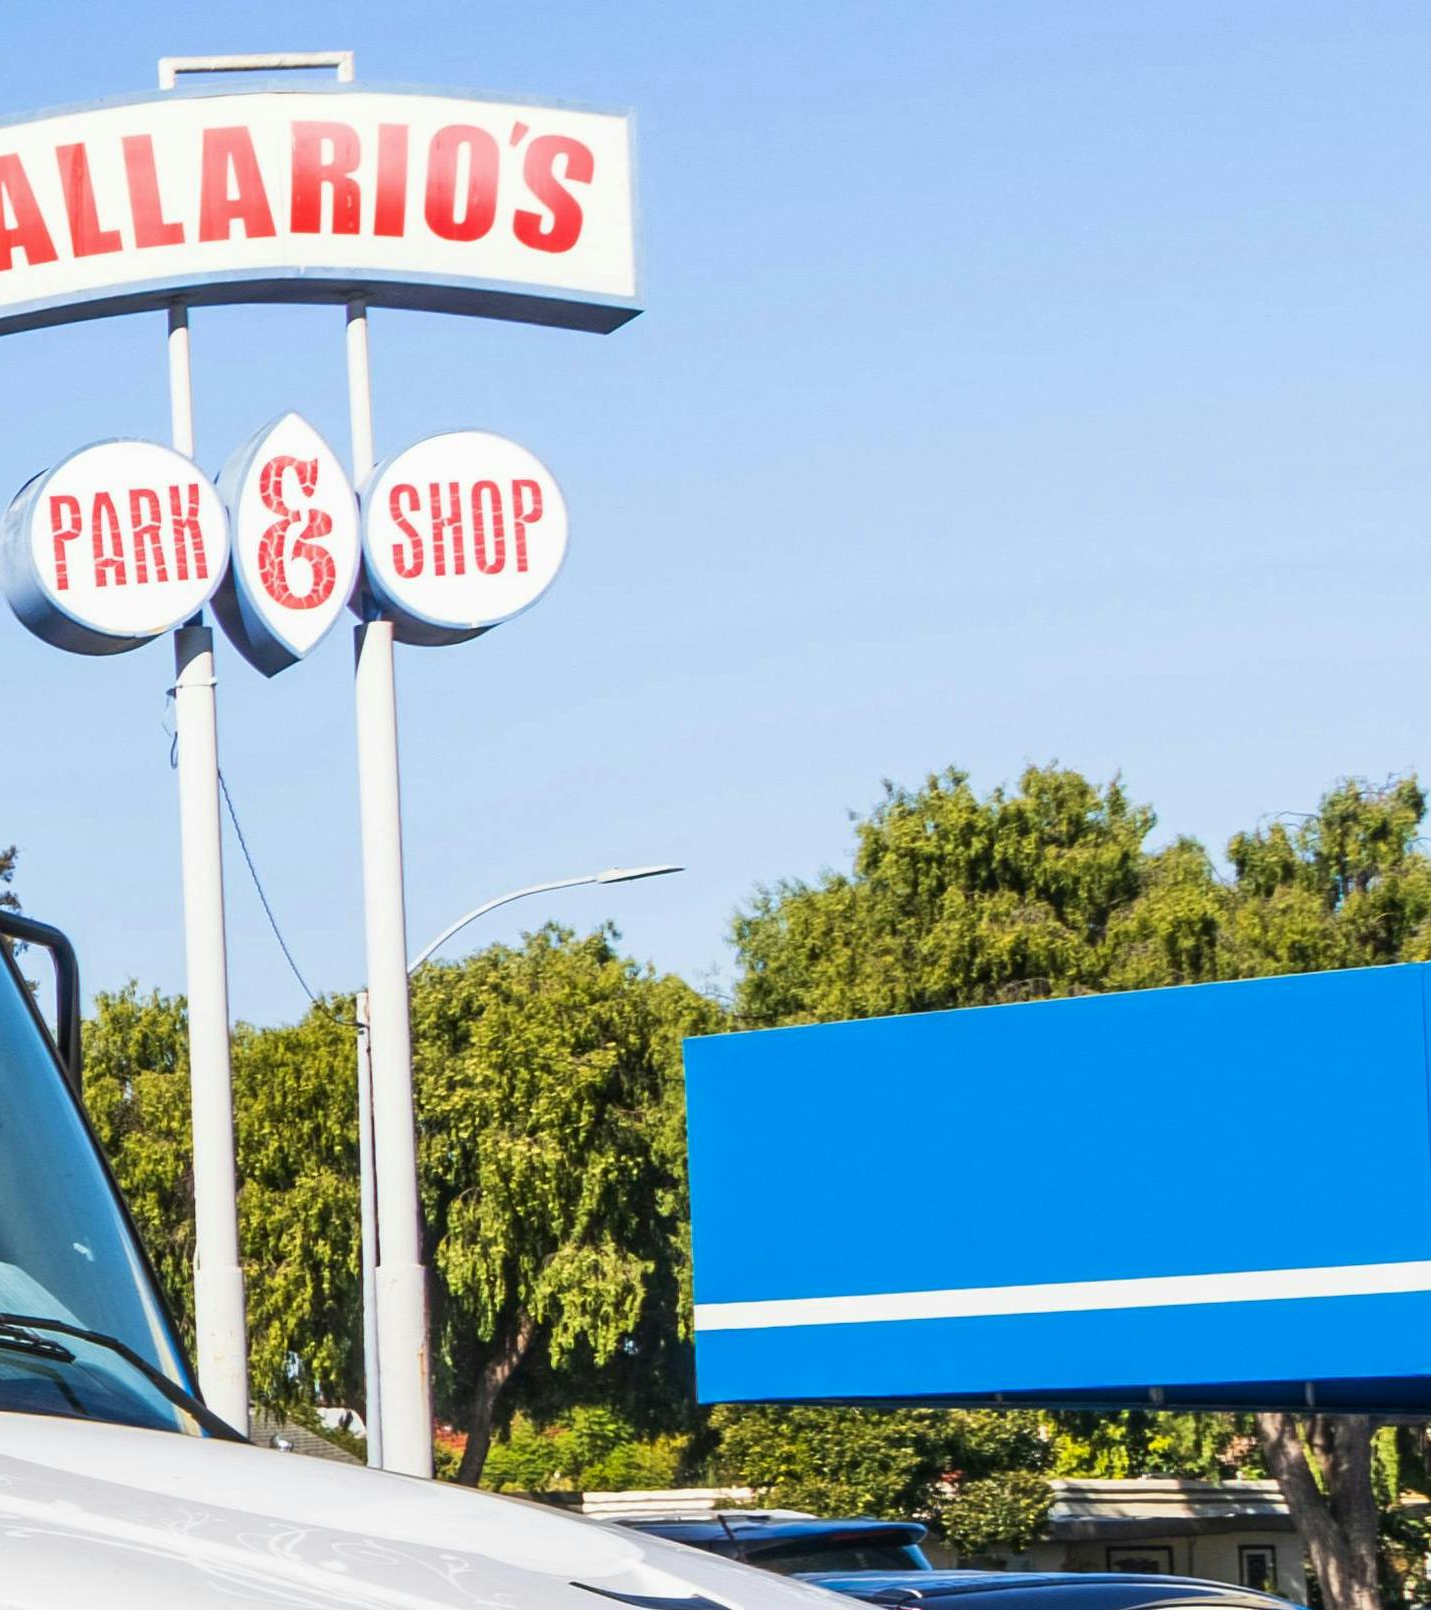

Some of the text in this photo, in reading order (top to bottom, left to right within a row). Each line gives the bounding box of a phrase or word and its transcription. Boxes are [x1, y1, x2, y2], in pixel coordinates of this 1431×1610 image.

[48, 455, 545, 610] PARK & SHOP
